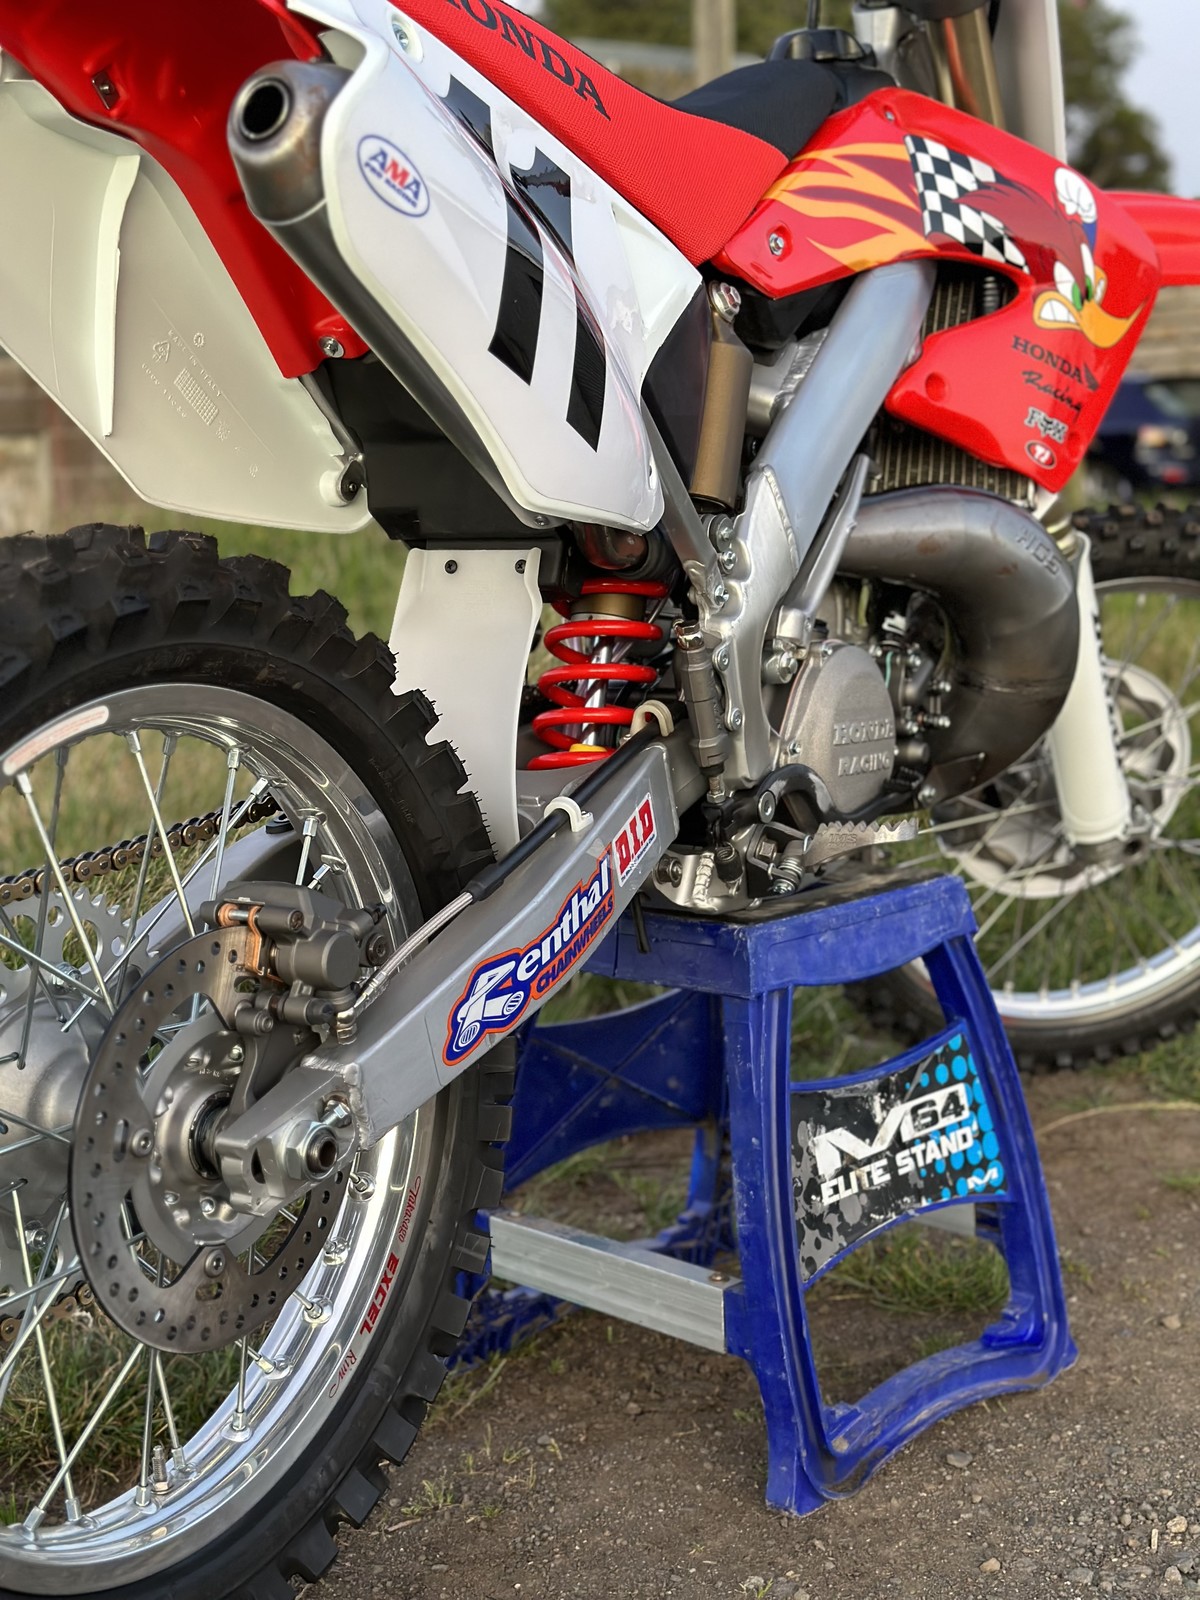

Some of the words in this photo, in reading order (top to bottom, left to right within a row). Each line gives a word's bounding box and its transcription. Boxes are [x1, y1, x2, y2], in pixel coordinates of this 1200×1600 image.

[445, 0, 611, 122] ONDA
[368, 147, 421, 201] AMA
[1011, 335, 1083, 385] HONDA
[1021, 369, 1082, 424] Racing
[832, 719, 894, 746] HONDA
[837, 751, 890, 777] RACING
[452, 858, 609, 1052] Renthal
[536, 895, 613, 993] CHAINWHEELS
[820, 1158, 891, 1206] ELITE
[895, 1126, 974, 1176] STAND
[398, 1176, 421, 1243] Takasago
[359, 1252, 400, 1336] EXCEL
